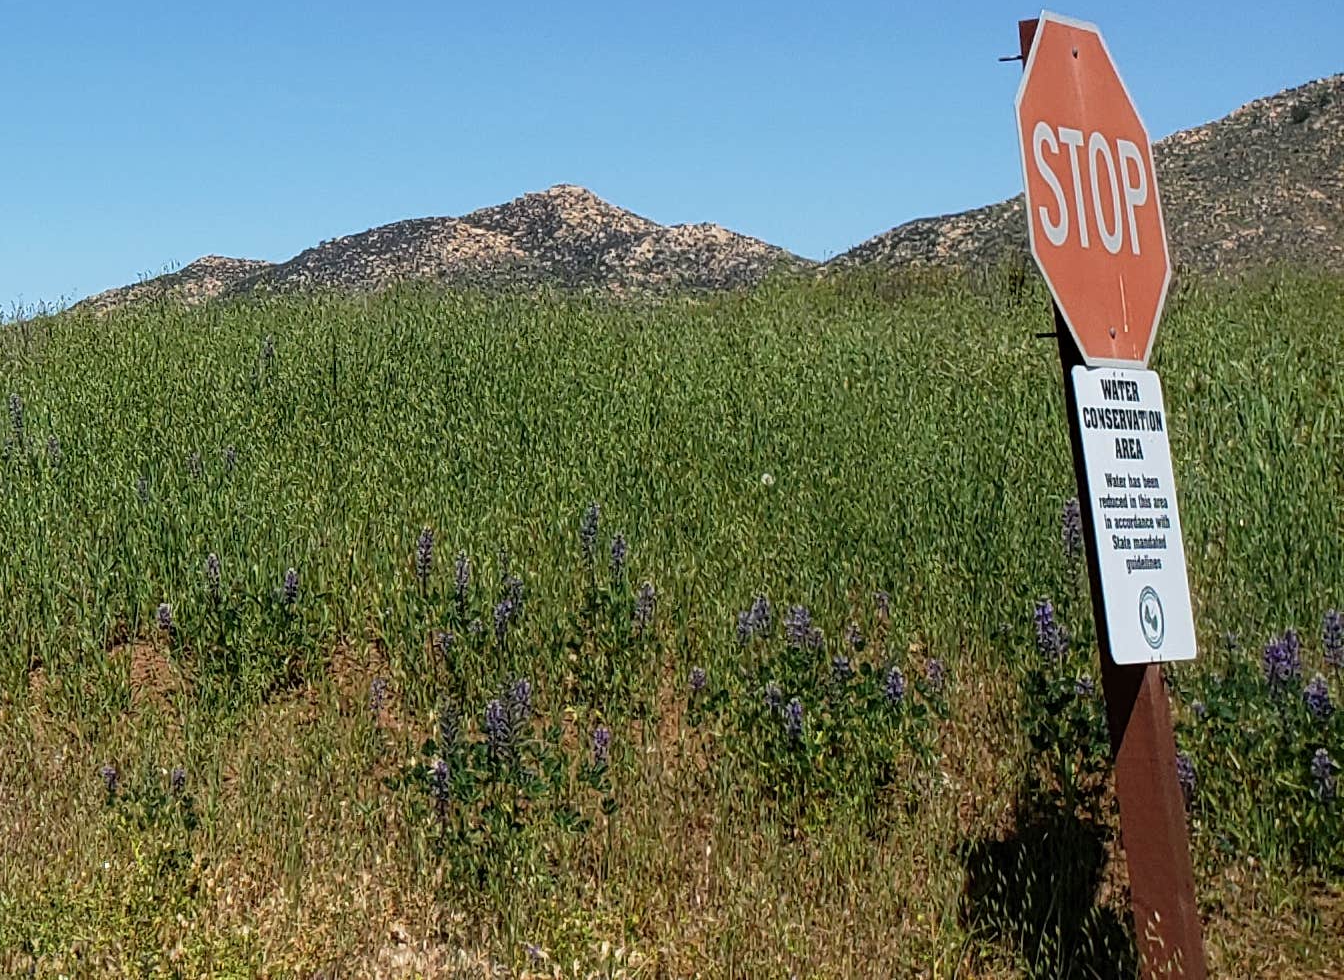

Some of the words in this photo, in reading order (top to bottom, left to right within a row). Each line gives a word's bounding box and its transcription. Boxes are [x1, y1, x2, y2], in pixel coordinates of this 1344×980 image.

[1033, 121, 1147, 256] STOP
[1100, 379, 1140, 401] WATER
[1083, 407, 1163, 431] CONSERVATION
[1116, 438, 1144, 460] AREA
[1105, 473, 1126, 488] Water
[1128, 473, 1141, 488] has
[1142, 474, 1159, 488] been
[1099, 494, 1128, 508] reduced
[1129, 494, 1137, 508] in
[1138, 494, 1151, 508] this
[1154, 498, 1168, 508] area
[1115, 514, 1154, 529] accordance
[1156, 515, 1170, 528] with
[1112, 535, 1131, 549] State
[1134, 535, 1166, 549] mandated
[1126, 555, 1162, 574] guidelines
